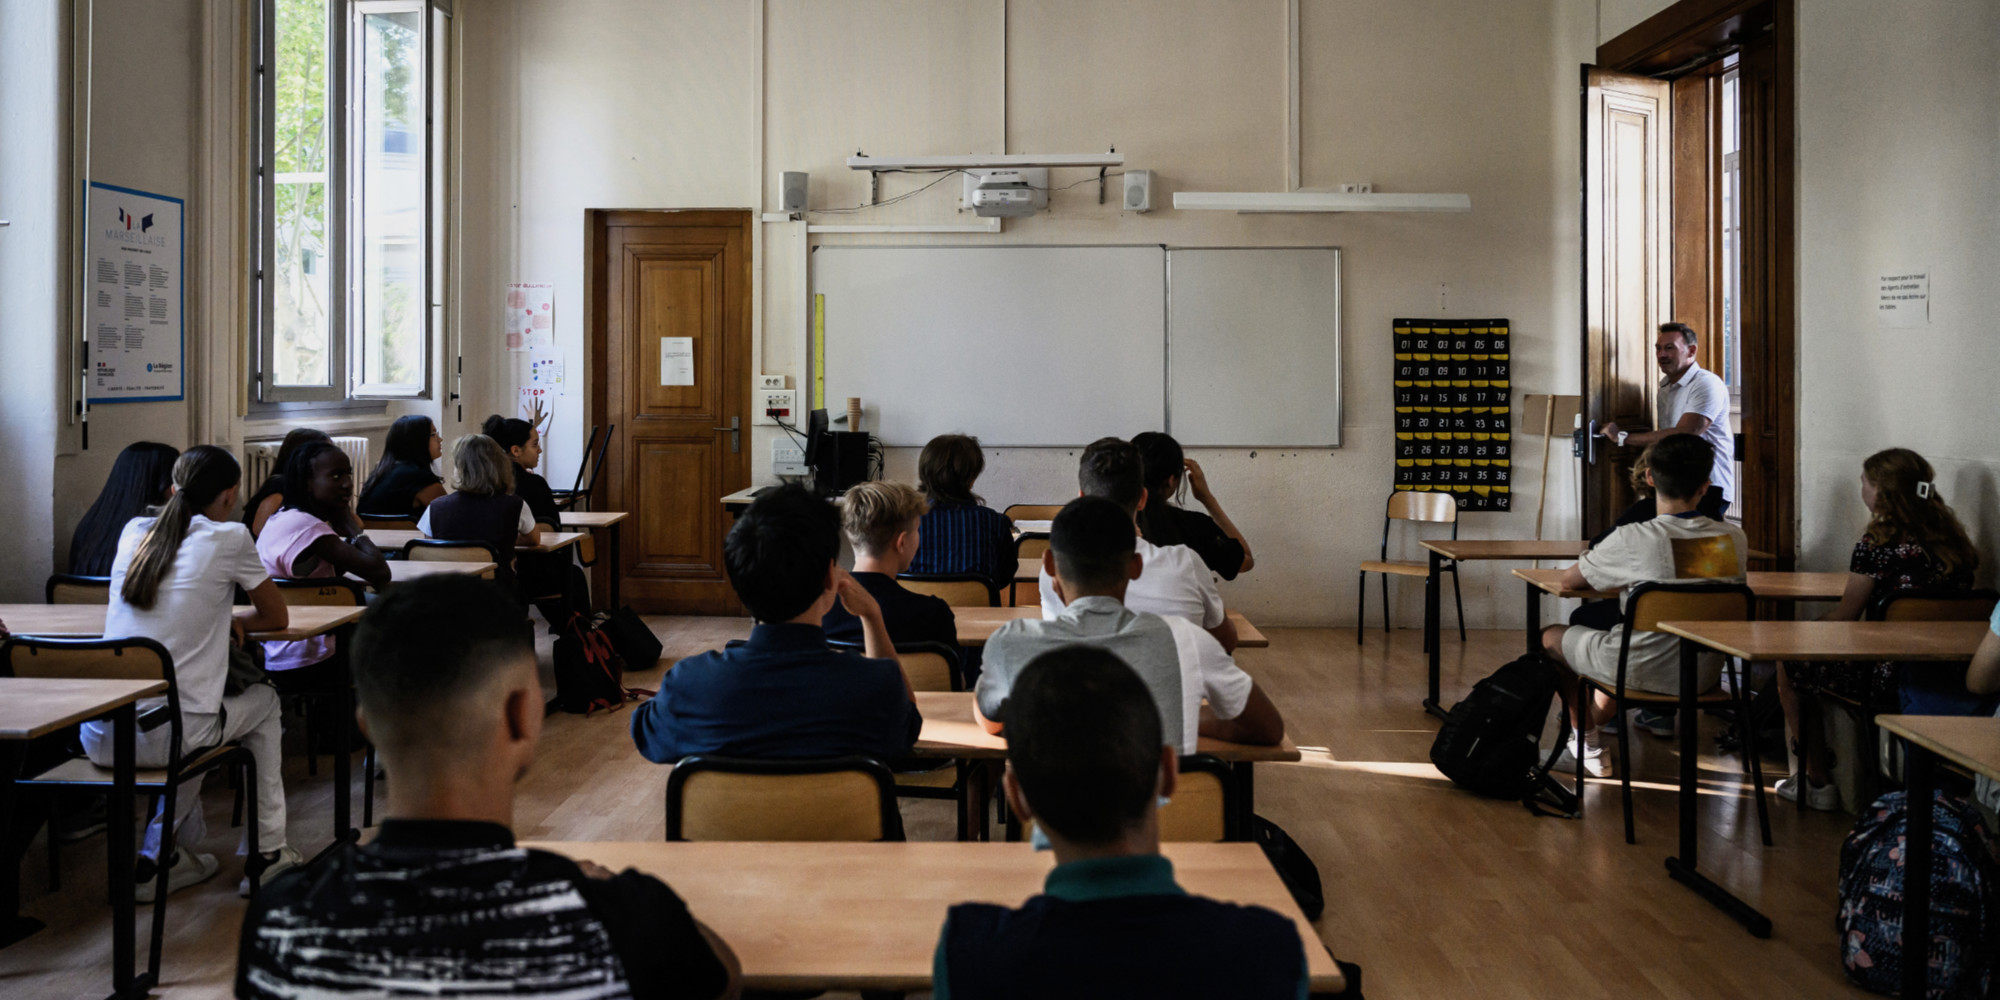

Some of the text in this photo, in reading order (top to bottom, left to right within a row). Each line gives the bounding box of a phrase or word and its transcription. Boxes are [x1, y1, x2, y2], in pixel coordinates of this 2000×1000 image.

[132, 221, 141, 231] LA
[105, 228, 167, 248] MARSEILLAISE
[1401, 340, 1504, 349] 01 02 03 04 05 06
[1401, 366, 1505, 376] 07 08 09 10 11 12
[522, 388, 545, 396] STOP
[1401, 393, 1410, 402] 13
[1439, 394, 1447, 402] 15
[1459, 394, 1467, 402] 16
[1477, 393, 1486, 401] 17
[1402, 418, 1505, 428] 19 20 21 22 23 24
[1404, 446, 1506, 455] 25 26 27 28 29 30
[1422, 472, 1431, 480] 32
[1440, 471, 1450, 479] 33
[1458, 472, 1468, 480] 34
[1477, 471, 1487, 479] 35
[1496, 471, 1507, 481] 36
[1496, 498, 1508, 508] 42
